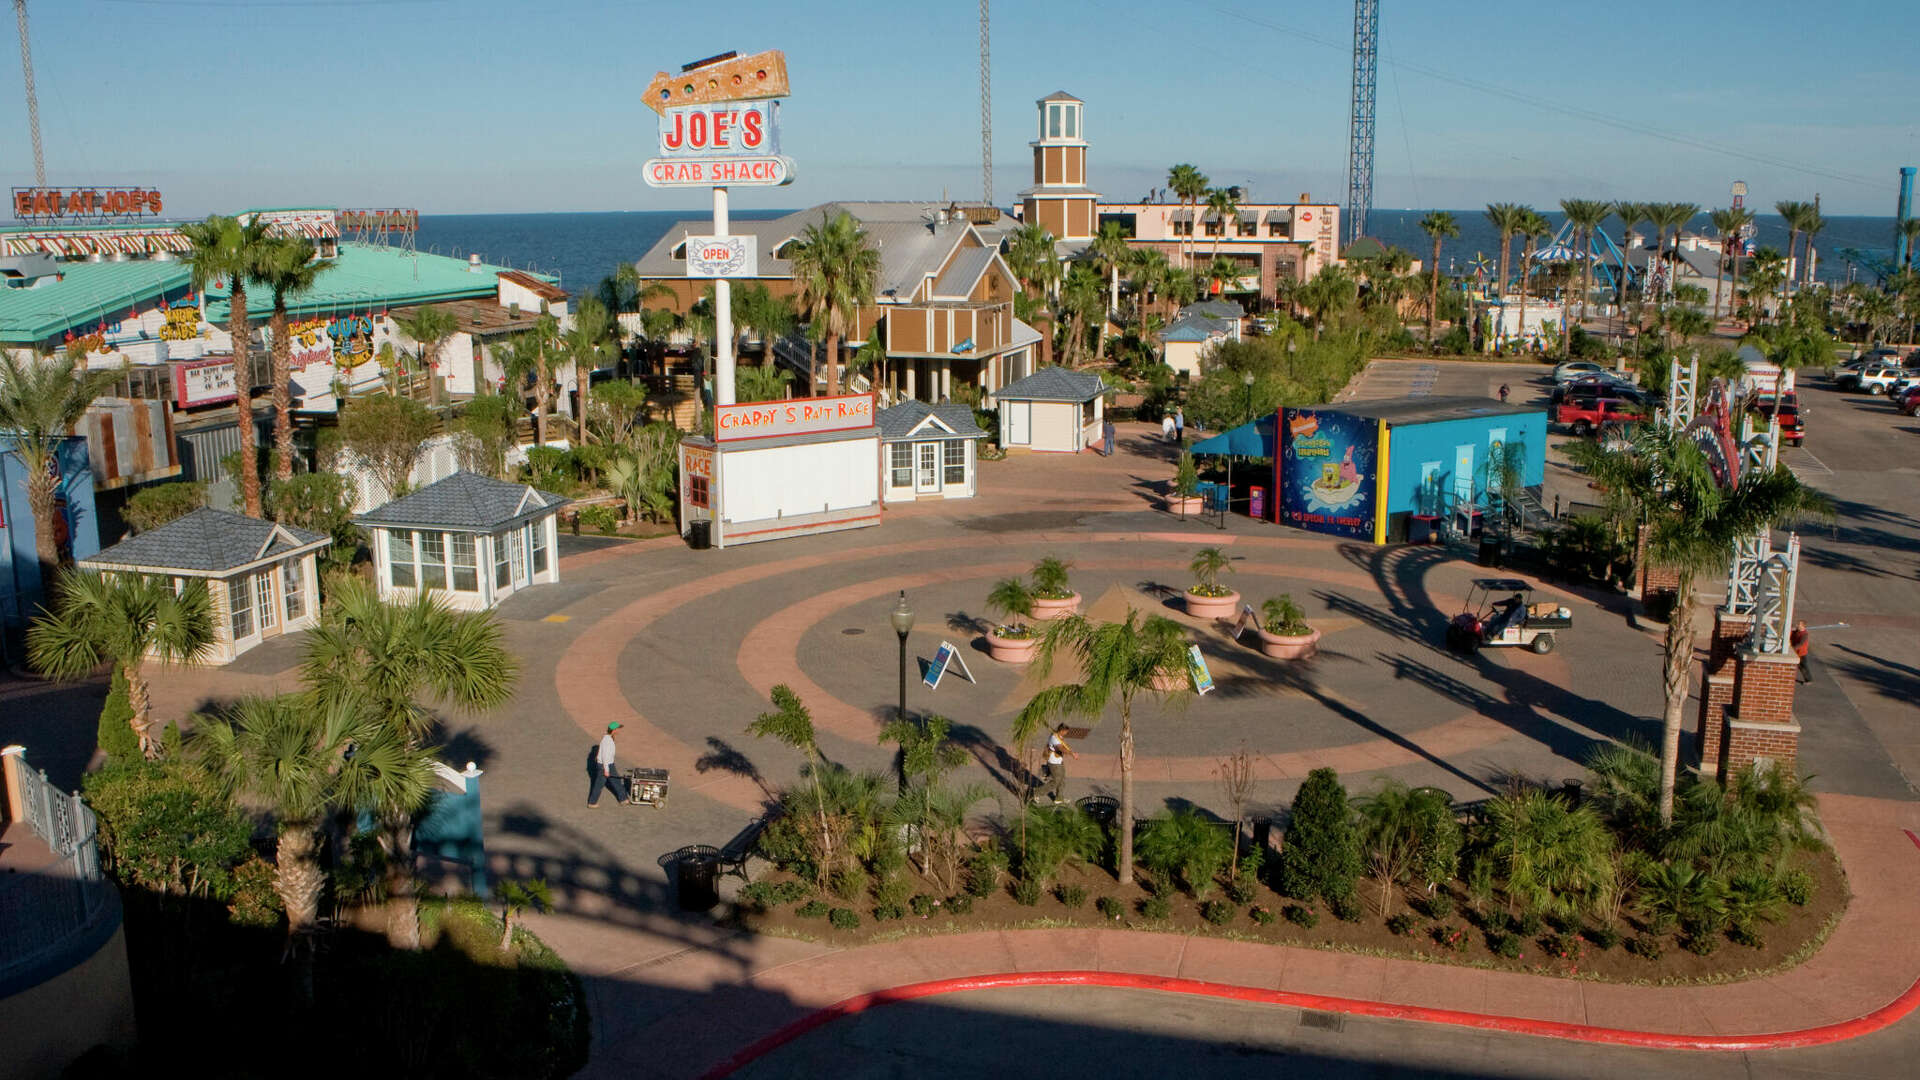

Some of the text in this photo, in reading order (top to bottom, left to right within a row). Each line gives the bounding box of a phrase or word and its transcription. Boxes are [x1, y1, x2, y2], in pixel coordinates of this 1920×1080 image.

[663, 109, 764, 149] JOE'S
[653, 162, 777, 181] CRAB SHACK
[16, 190, 163, 214] EAT AT JOE'S
[703, 248, 730, 261] OPEN
[300, 331, 317, 348] TO
[804, 404, 833, 422] BAIT
[838, 400, 869, 418] RACE
[684, 455, 712, 477] RACE
